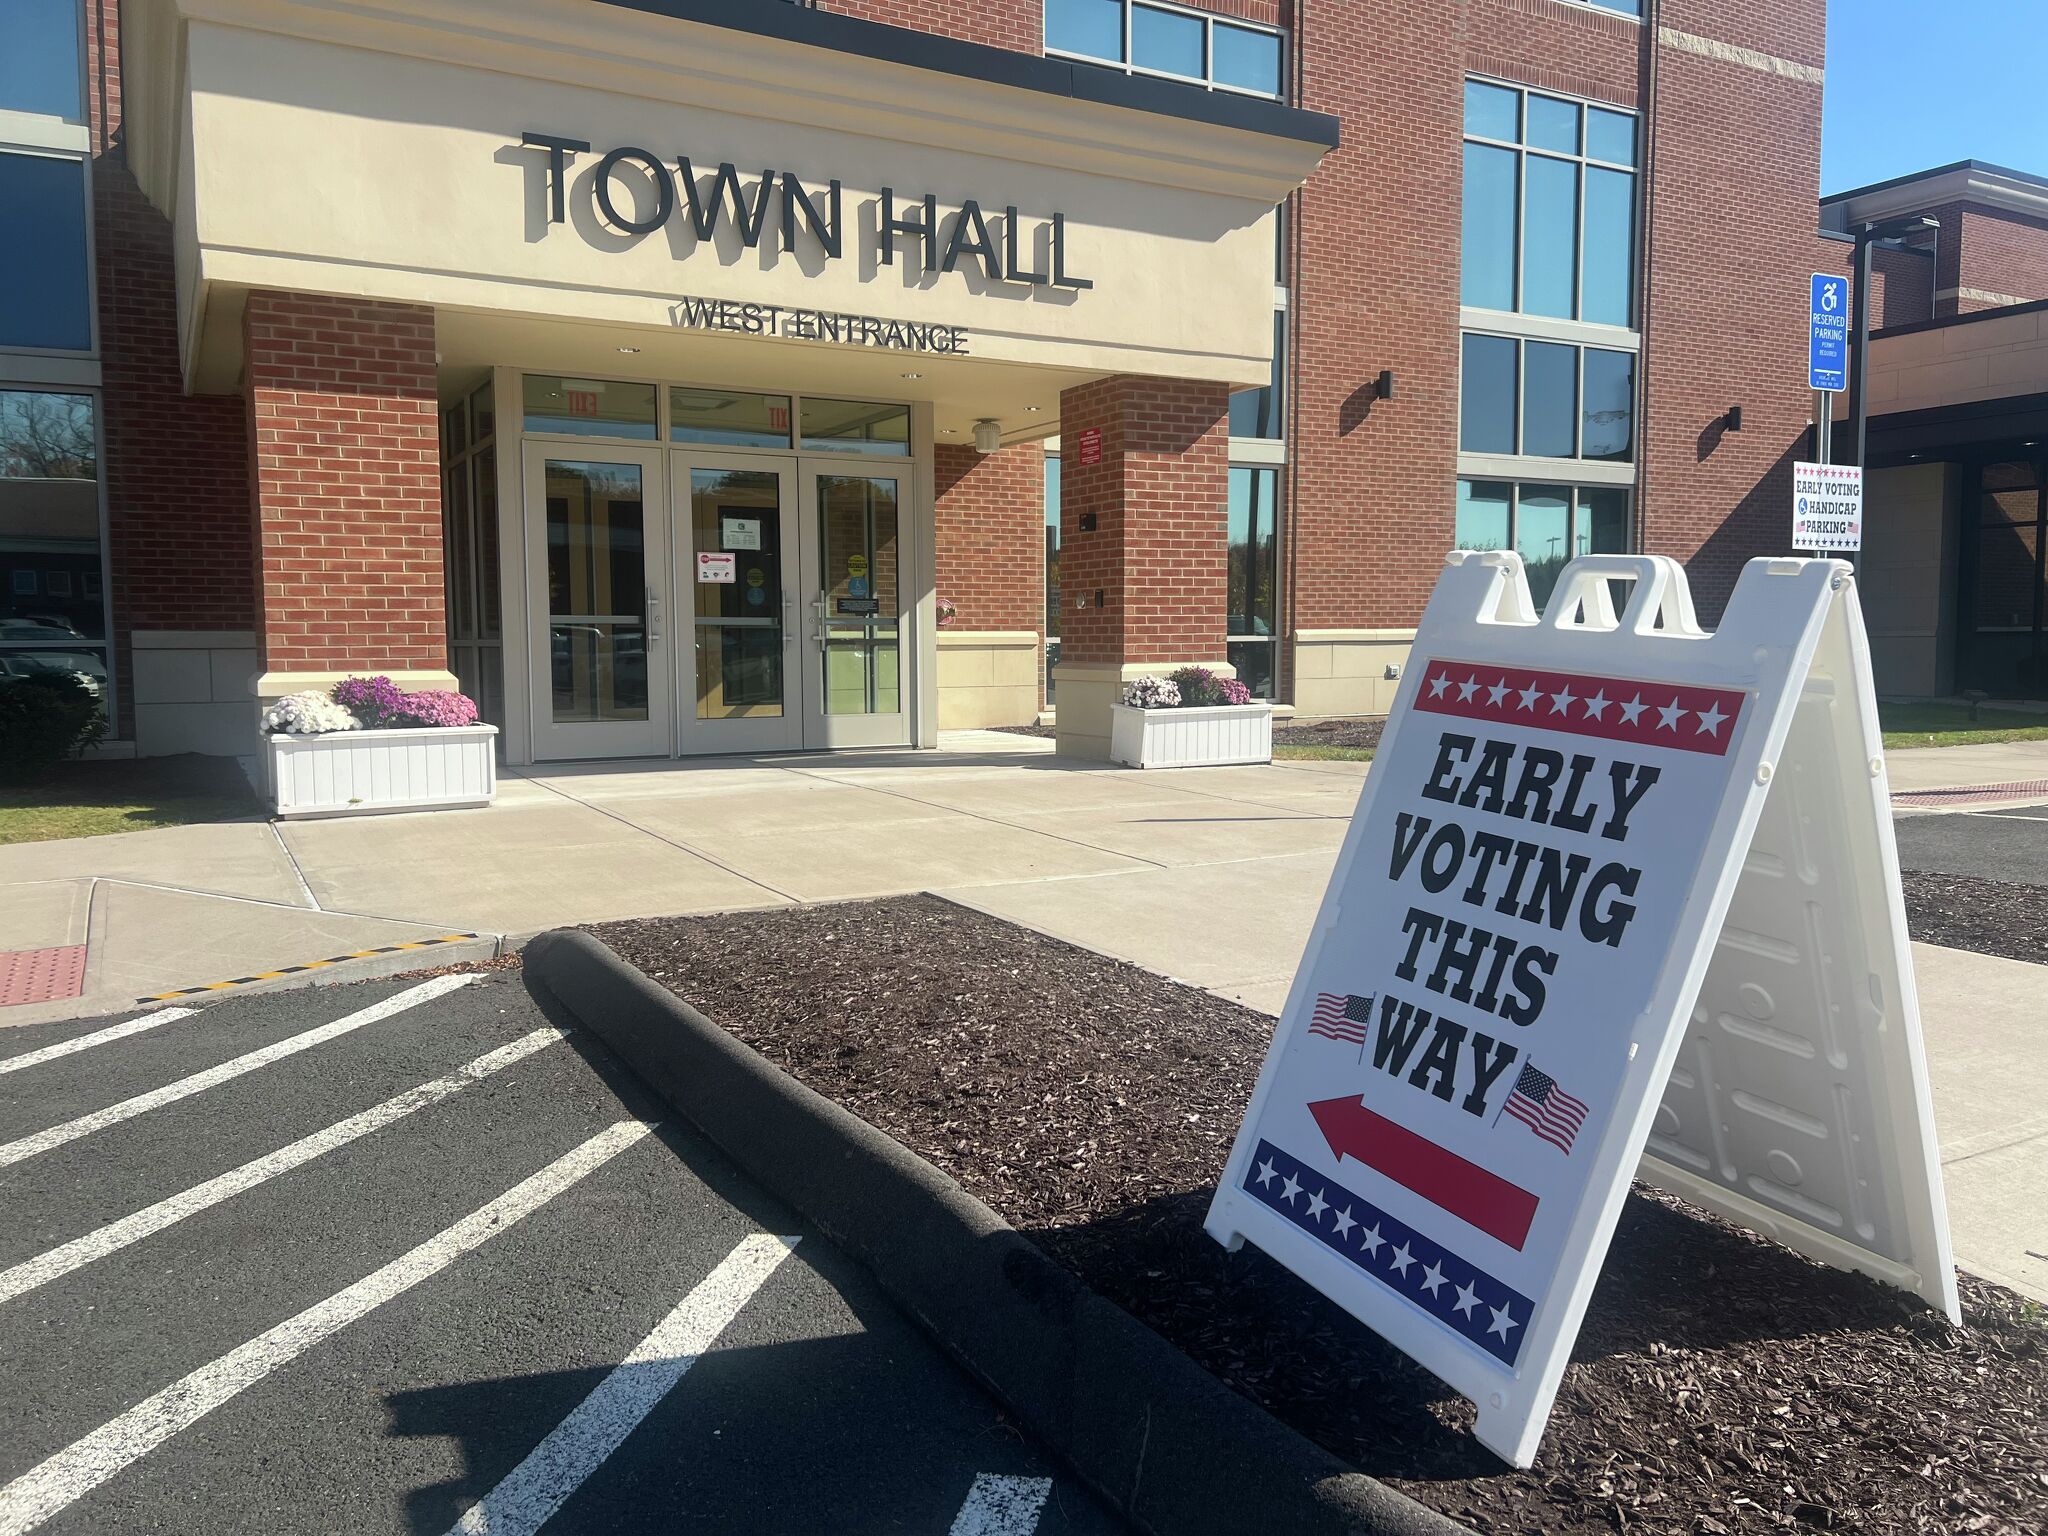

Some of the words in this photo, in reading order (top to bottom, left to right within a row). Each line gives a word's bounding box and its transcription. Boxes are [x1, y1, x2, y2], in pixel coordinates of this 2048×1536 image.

[522, 131, 842, 259] TOWN
[882, 186, 1094, 290] HALL
[683, 296, 784, 335] WEST
[796, 309, 970, 355] ENTRANCE
[1813, 313, 1845, 327] RESERVED
[1814, 327, 1843, 341] PARKING
[1796, 480, 1823, 495] EARLY
[1825, 482, 1860, 497] VOTING
[1809, 500, 1857, 516] HANDICAP
[1806, 520, 1847, 534] PARKING
[1421, 732, 1662, 842] EARLY
[1388, 811, 1642, 948] VOTING
[1395, 906, 1560, 1027] THIS
[1372, 994, 1519, 1118] WAY
